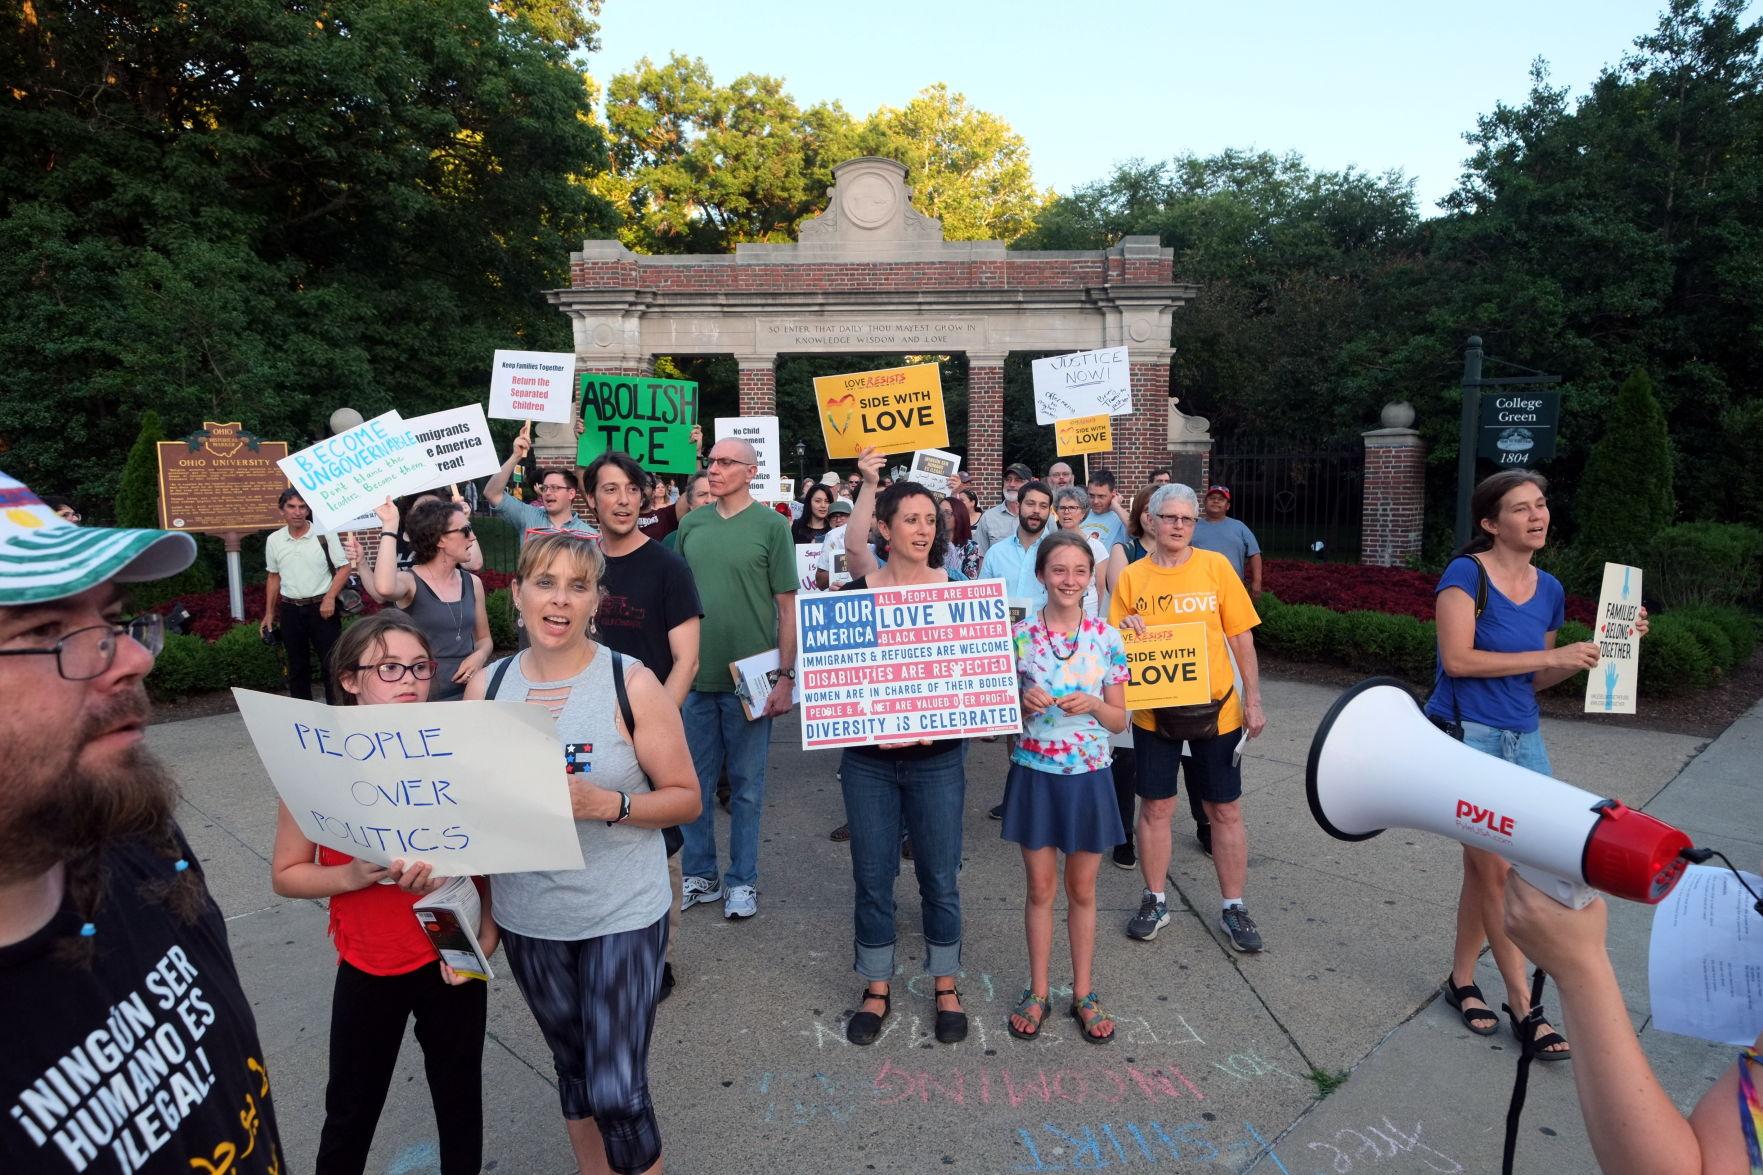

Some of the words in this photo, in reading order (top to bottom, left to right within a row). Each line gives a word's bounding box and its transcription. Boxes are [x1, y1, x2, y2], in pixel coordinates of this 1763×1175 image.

[767, 325, 780, 333] SO
[784, 325, 809, 333] ENTER
[814, 325, 835, 333] THAT
[839, 324, 864, 333] DAILY
[868, 324, 891, 332] THOU
[895, 323, 929, 332] MAYEST
[934, 323, 963, 332] GROW
[967, 323, 976, 331] IN
[795, 336, 850, 344] KNOWLEDGE
[902, 335, 920, 343] AND
[925, 335, 948, 343] LOVE
[539, 364, 564, 372] Together
[1051, 351, 1122, 370] JUSTICE
[512, 376, 536, 386] Return
[537, 377, 550, 387] the
[844, 378, 865, 388] LOVE
[866, 373, 906, 387] RESISTS
[510, 388, 549, 399] Separated
[579, 380, 698, 426] ABOLISH
[859, 395, 890, 409] SIDE
[893, 390, 931, 405] WITH
[512, 400, 545, 411] Children
[1496, 398, 1543, 411] College
[861, 405, 934, 434] LOVE
[1498, 411, 1537, 422] Green
[212, 428, 233, 436] OHIO
[415, 423, 470, 443] migrants
[742, 427, 760, 435] Child
[1076, 432, 1107, 444] LOVE
[1090, 425, 1106, 433] WITH
[294, 420, 388, 473] BECOME
[435, 436, 482, 456] America
[598, 426, 669, 466] ICE
[179, 459, 206, 467] OHIO
[212, 458, 271, 467] UNIVERSITY
[299, 431, 417, 491] UNGOVERNABLE
[435, 456, 465, 472] reat!
[1500, 453, 1529, 463] 1804
[320, 482, 347, 500] Don't
[384, 455, 405, 469] the
[363, 474, 398, 493] Become
[879, 594, 897, 604] ALL
[901, 590, 938, 602] PEOPLE
[943, 588, 962, 599] ARE
[967, 586, 998, 598] EQUAL
[1173, 595, 1217, 614] LOVE
[804, 603, 825, 627] IN
[835, 600, 873, 624] OUR
[880, 604, 935, 628] LOVE
[948, 599, 1006, 623] WINS
[1605, 602, 1638, 622] FAMILIES
[806, 626, 874, 648] AMERICA
[882, 631, 916, 643] BLACK
[922, 628, 953, 641] LIVES
[960, 624, 1003, 637] MATTER
[1122, 633, 1134, 641] VE
[1605, 622, 1630, 640] BELONG
[803, 652, 866, 668] IMMIGRANTS
[870, 651, 877, 662] &
[936, 644, 955, 656] ARE
[960, 641, 1009, 654] WELCOME
[1126, 651, 1156, 663] SIDE
[1161, 647, 1196, 660] WITH
[1600, 641, 1632, 659] TOGETHER
[808, 667, 894, 687] DISABILITIES
[901, 663, 925, 678] ARE
[933, 658, 1007, 677] RESPECTED
[1127, 662, 1198, 687] LOVE
[805, 690, 840, 703] WOMEN
[846, 688, 865, 699] ARE
[869, 687, 880, 698] IN
[885, 684, 922, 696] CHARGE
[927, 682, 939, 693] OF
[945, 680, 974, 692] THEIR
[979, 676, 1014, 689] BODIES
[810, 705, 842, 718] PEOPLE
[895, 700, 913, 711] ARE
[916, 697, 950, 709] VALUED
[980, 692, 1010, 705] PROFIT
[806, 717, 886, 739] DIVERSITY
[896, 716, 911, 732] IS
[920, 707, 1018, 730] CELEBRATED
[294, 722, 453, 761] PEOPLE
[350, 779, 458, 807] OVER
[1456, 799, 1515, 837] PYLE
[310, 809, 470, 852] POLITICS
[145, 944, 198, 1010] SER
[52, 1021, 187, 1174] HUMANO
[176, 986, 216, 1043] ES
